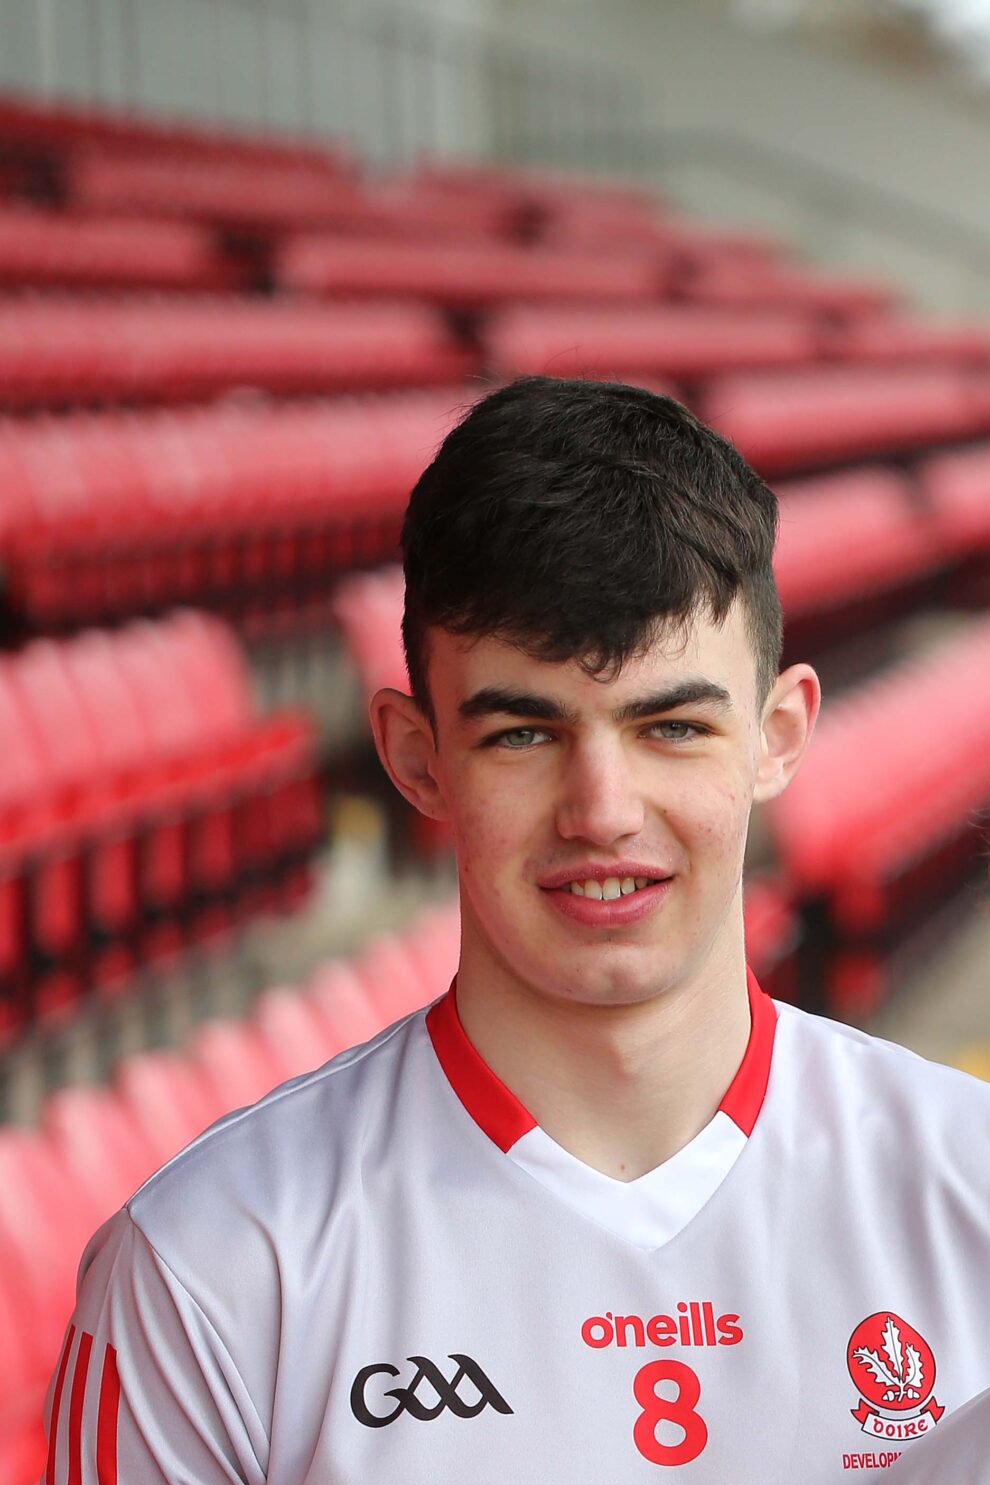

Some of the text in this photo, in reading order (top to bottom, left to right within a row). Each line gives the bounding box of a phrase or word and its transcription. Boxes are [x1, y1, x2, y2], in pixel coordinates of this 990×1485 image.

[581, 1301, 744, 1349] o'neills
[350, 1354, 514, 1428] GAA
[633, 1359, 708, 1466] 8
